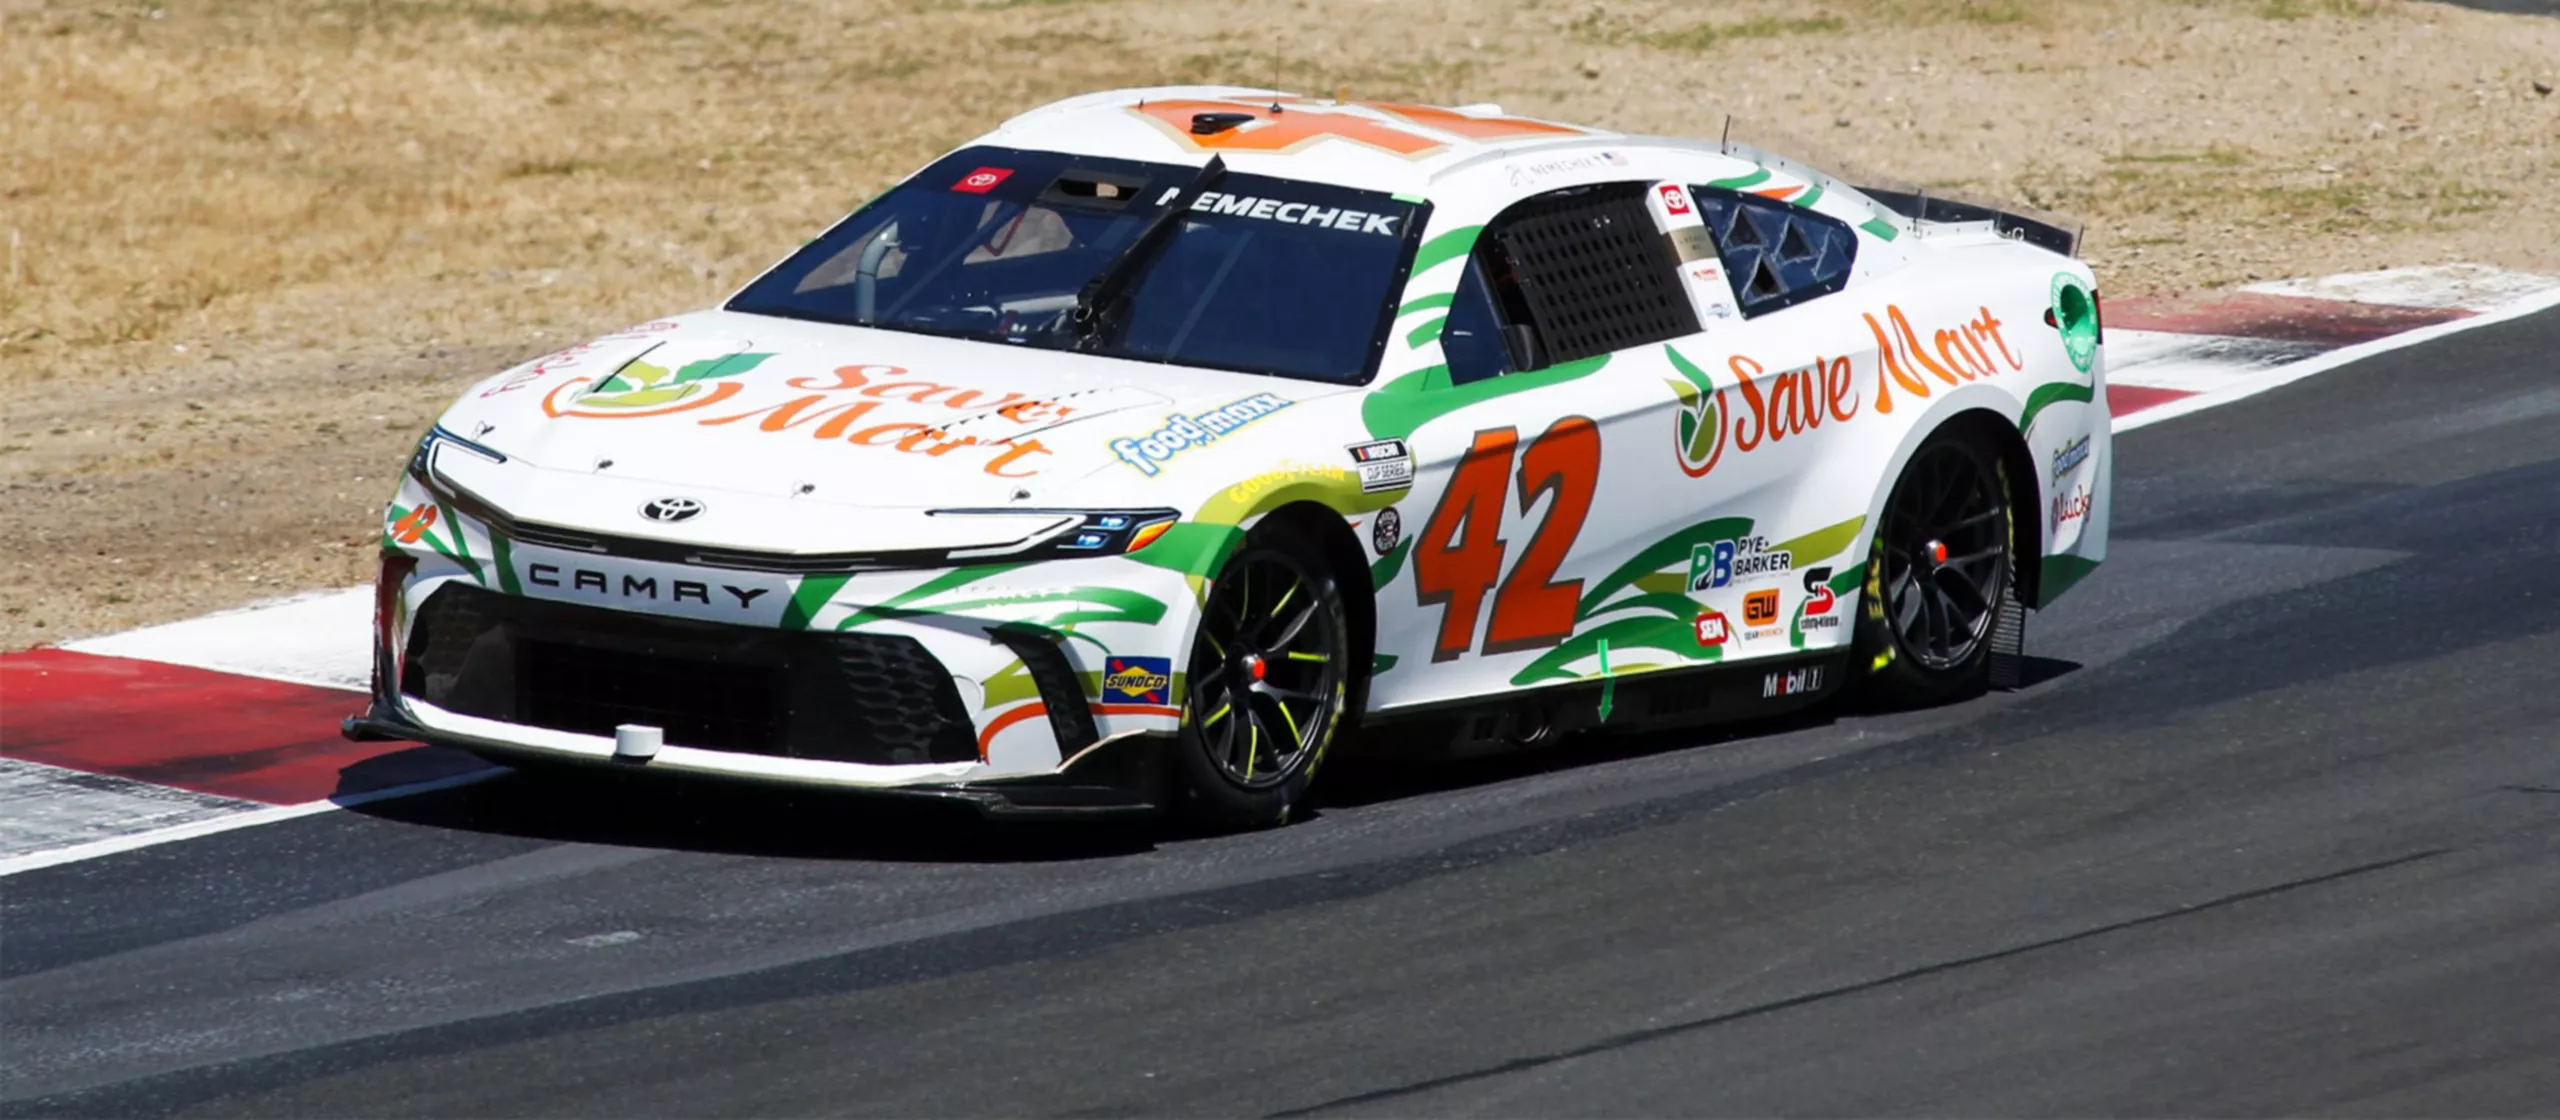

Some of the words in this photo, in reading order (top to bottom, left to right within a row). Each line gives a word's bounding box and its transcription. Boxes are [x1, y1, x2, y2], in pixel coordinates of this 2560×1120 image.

[785, 364, 1077, 425] Save
[1728, 354, 1859, 452] Save
[1862, 304, 2024, 414] Mart
[698, 394, 1054, 478] Mart
[391, 503, 437, 544] 42
[1411, 414, 1602, 664] 42
[529, 563, 769, 609] CAMRY
[1688, 541, 1735, 592] PB
[1735, 553, 1790, 576] BARKER
[1107, 675, 1166, 689] SUNOCO
[1763, 667, 1807, 698] Mobil
